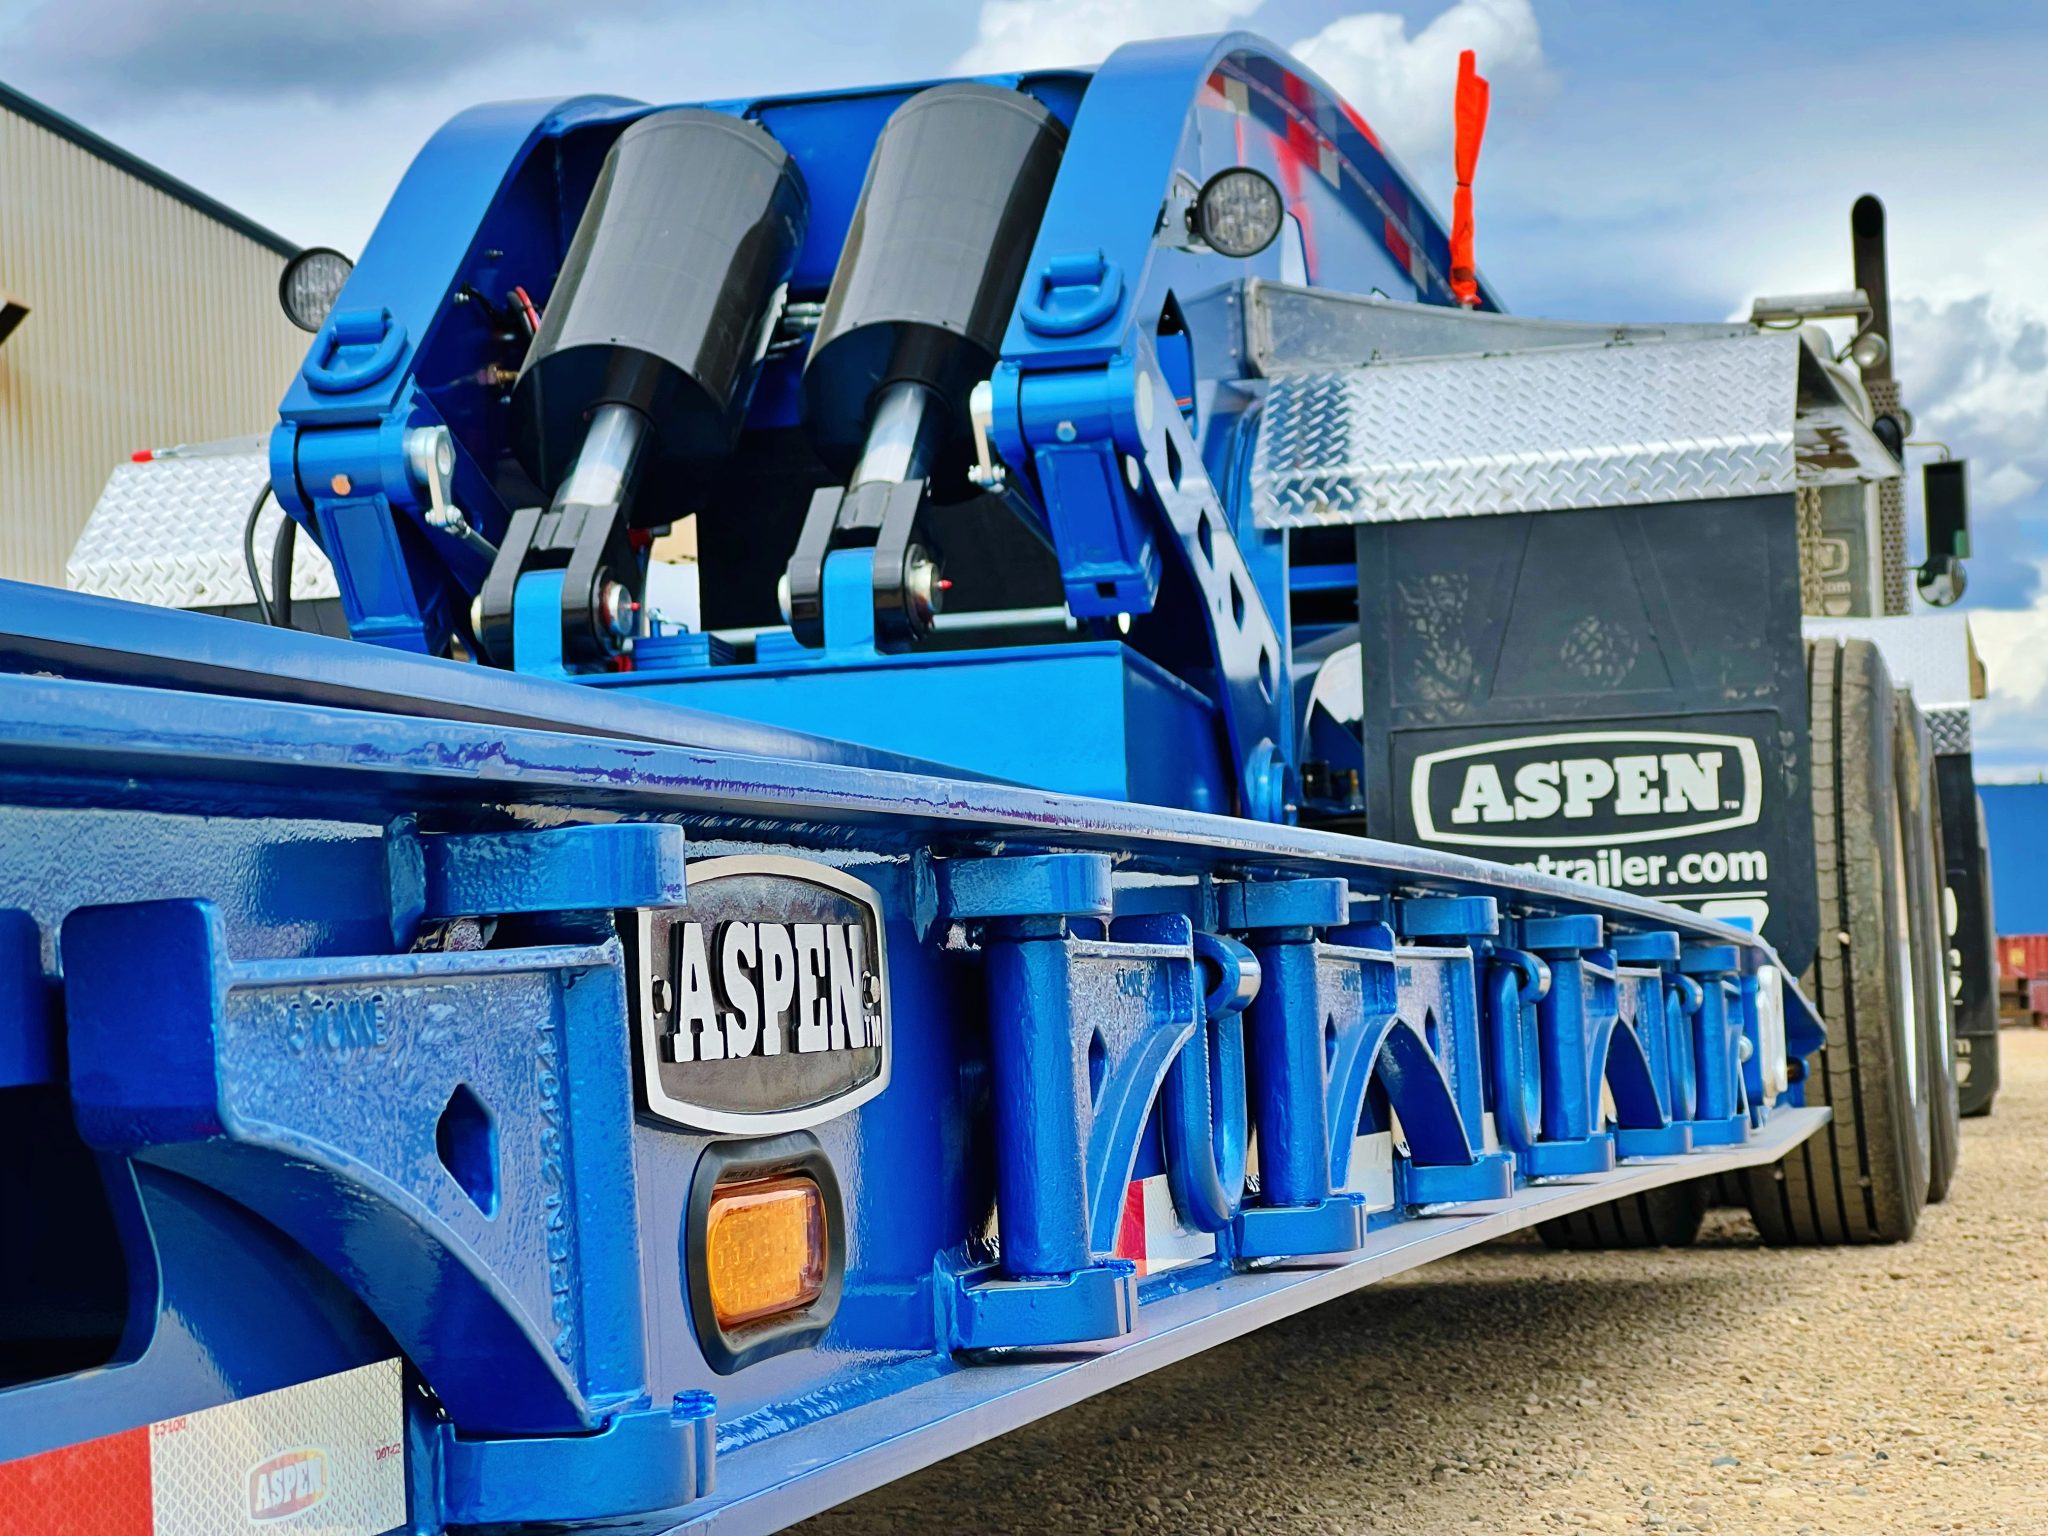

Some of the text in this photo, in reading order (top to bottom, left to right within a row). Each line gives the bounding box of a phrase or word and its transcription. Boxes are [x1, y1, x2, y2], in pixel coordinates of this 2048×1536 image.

[1452, 752, 1722, 823] ASPEN
[672, 920, 865, 1063] ASPEN
[255, 1457, 322, 1512] ASPEN
